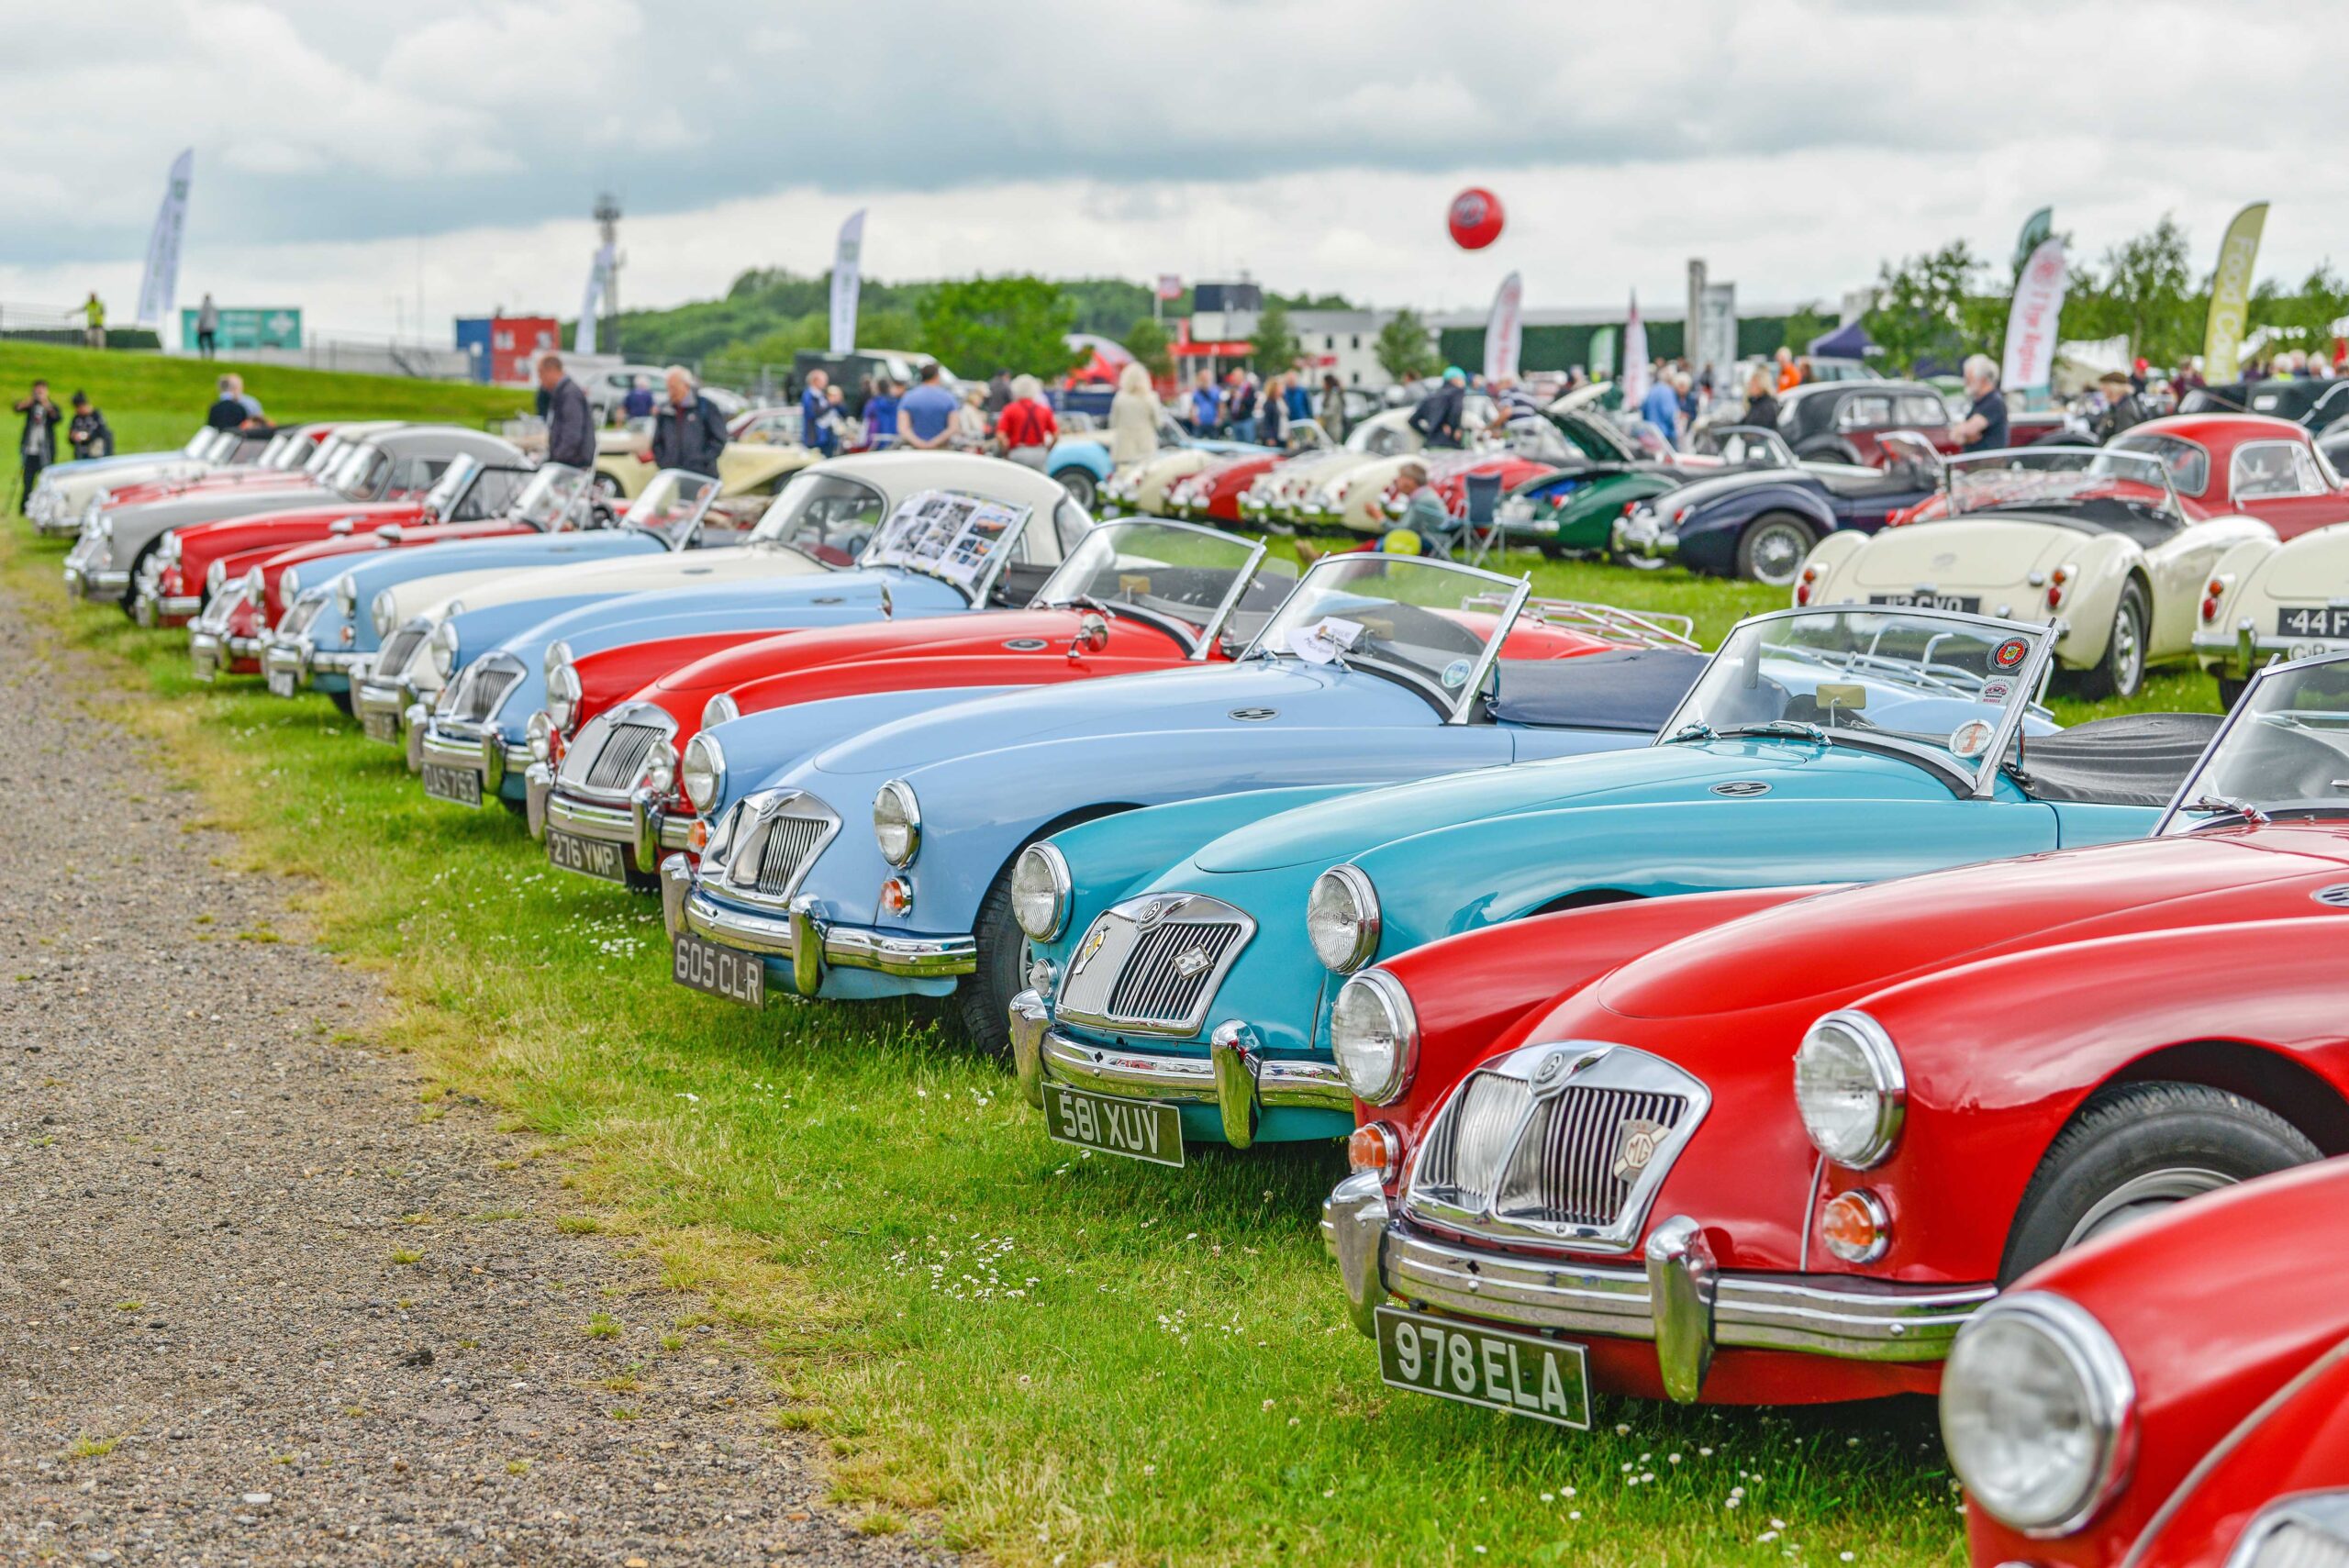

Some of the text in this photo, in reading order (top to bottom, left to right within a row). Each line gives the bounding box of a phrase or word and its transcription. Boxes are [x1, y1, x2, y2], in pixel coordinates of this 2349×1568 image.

[2220, 235, 2254, 305] Food
[2291, 609, 2328, 635] 44
[1628, 1137, 1651, 1163] MG
